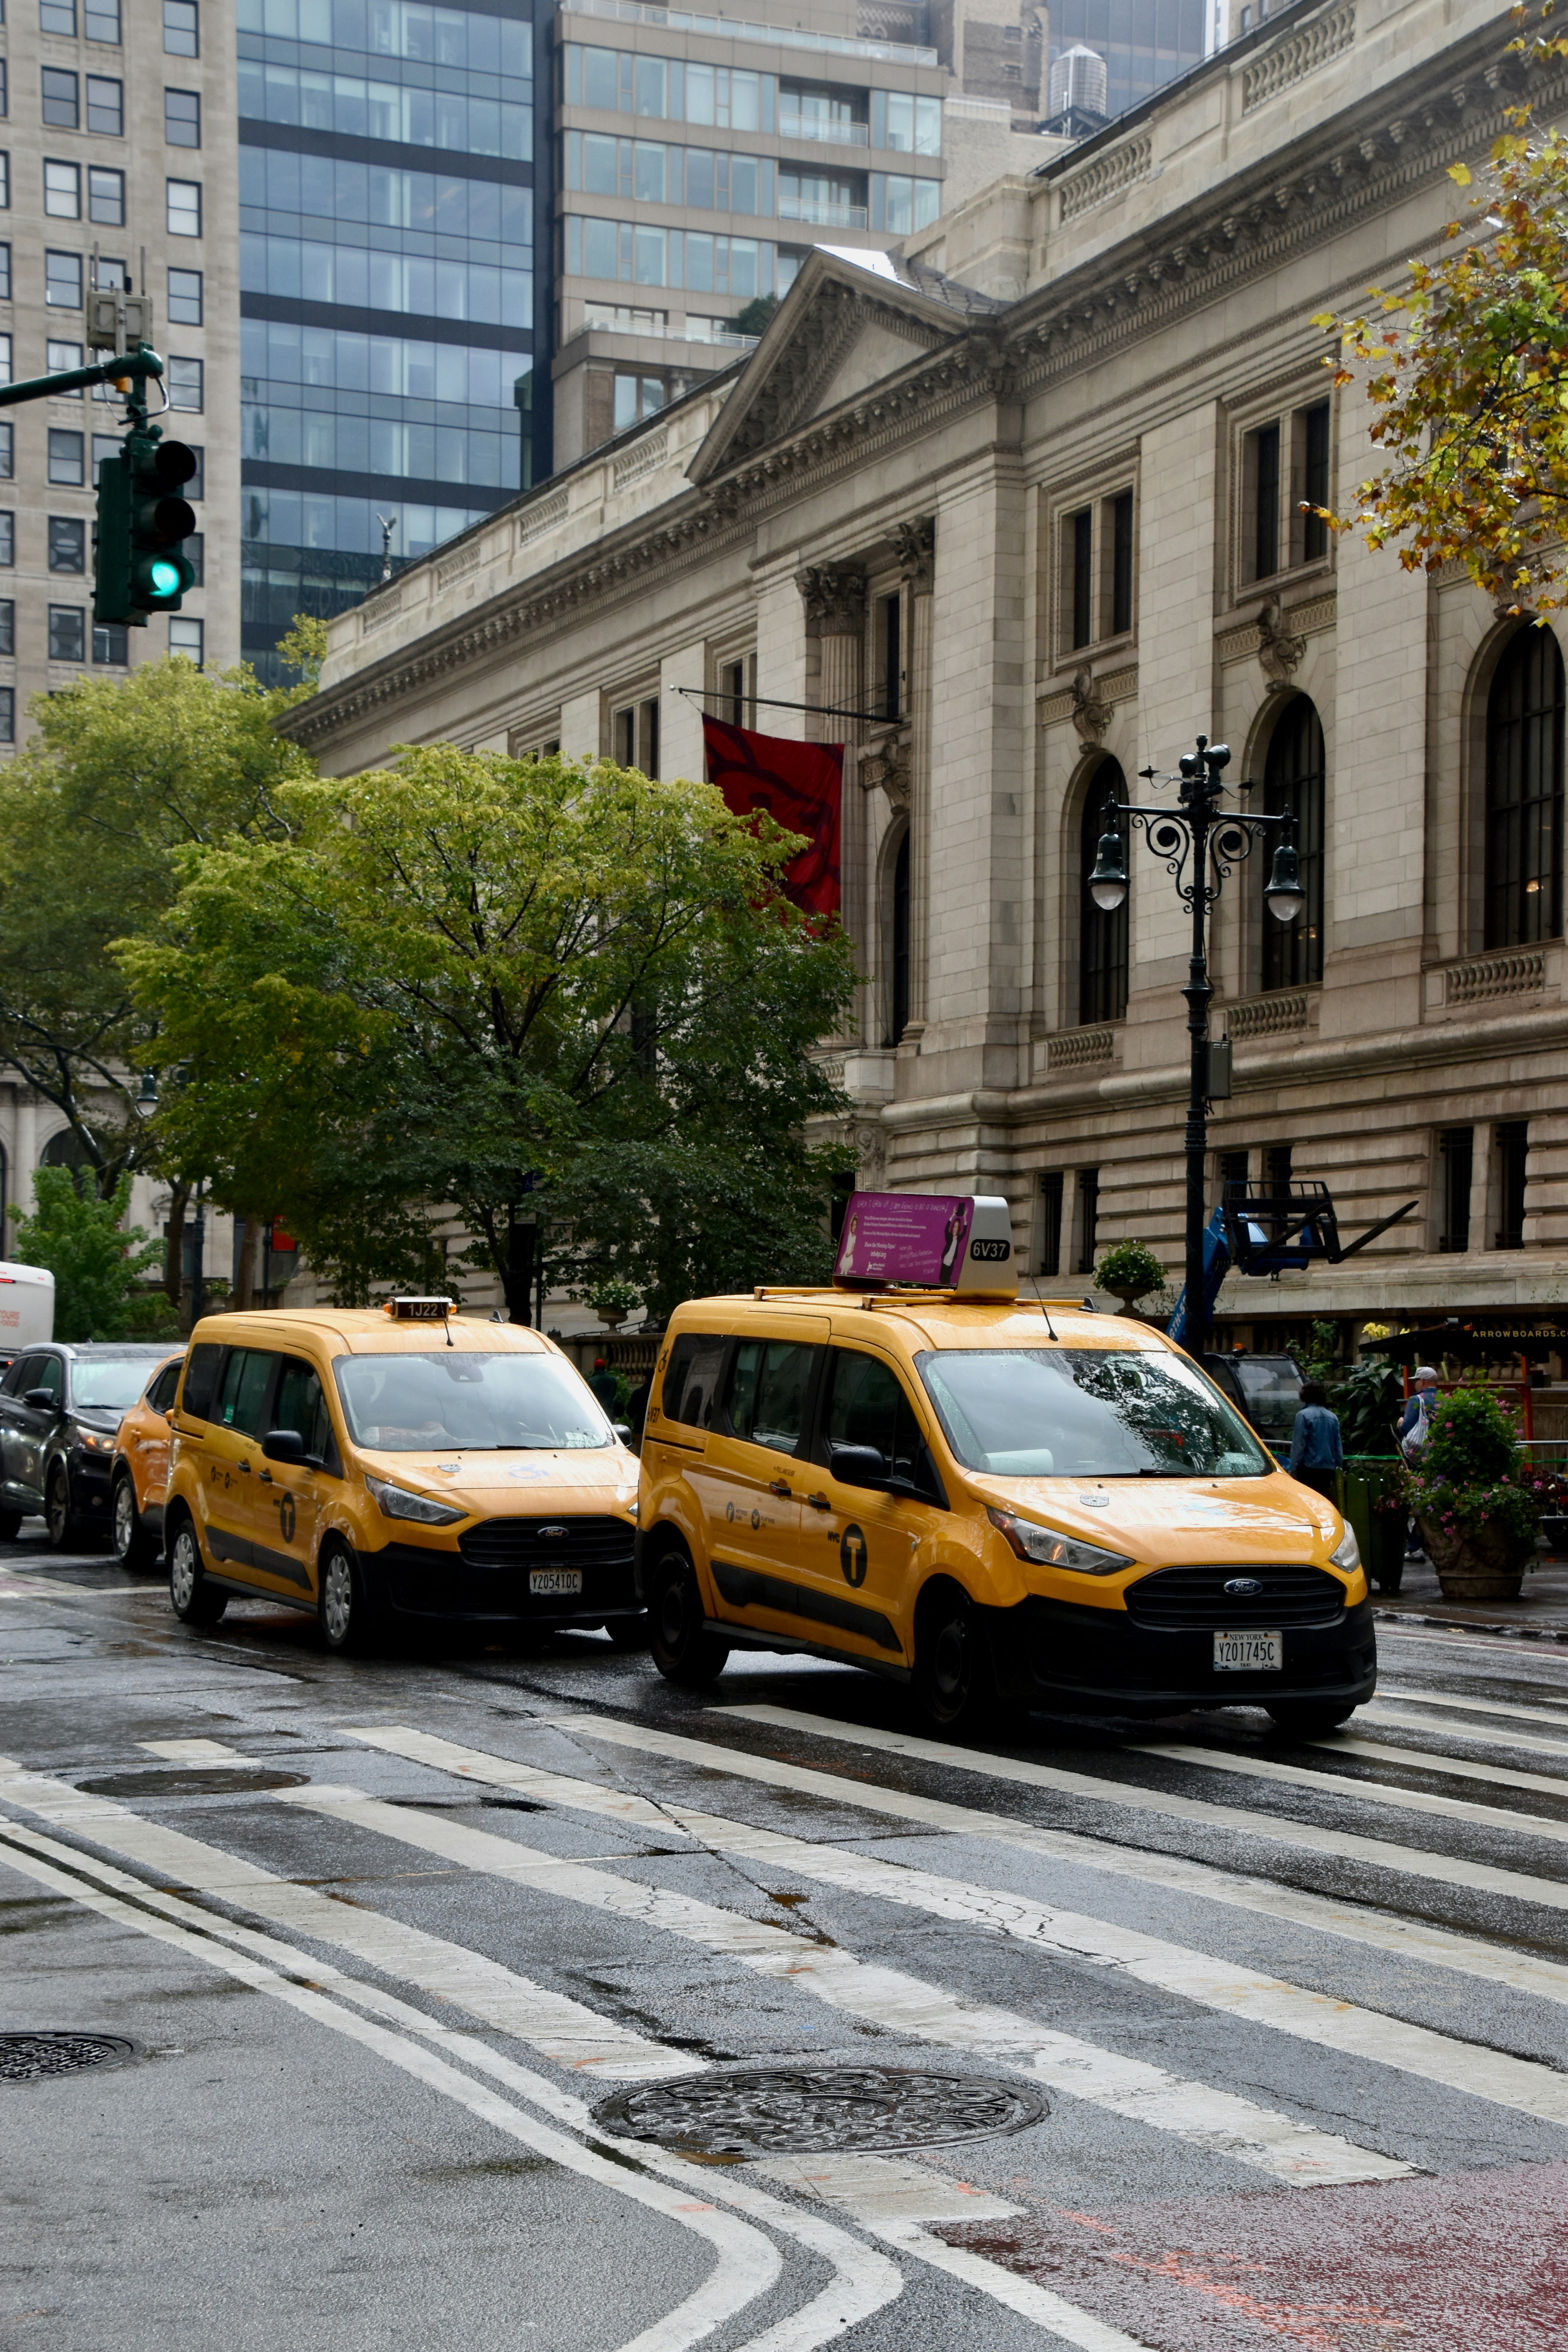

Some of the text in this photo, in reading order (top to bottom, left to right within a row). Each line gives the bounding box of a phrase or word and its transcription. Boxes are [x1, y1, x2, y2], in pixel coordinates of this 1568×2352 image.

[973, 1242, 1007, 1258] 6V37
[409, 1303, 438, 1316] 1J22
[828, 1530, 840, 1543] NYC
[532, 1573, 578, 1589] Y205410C
[1234, 1581, 1256, 1592] Ford
[1219, 1642, 1274, 1662] Y201745C
